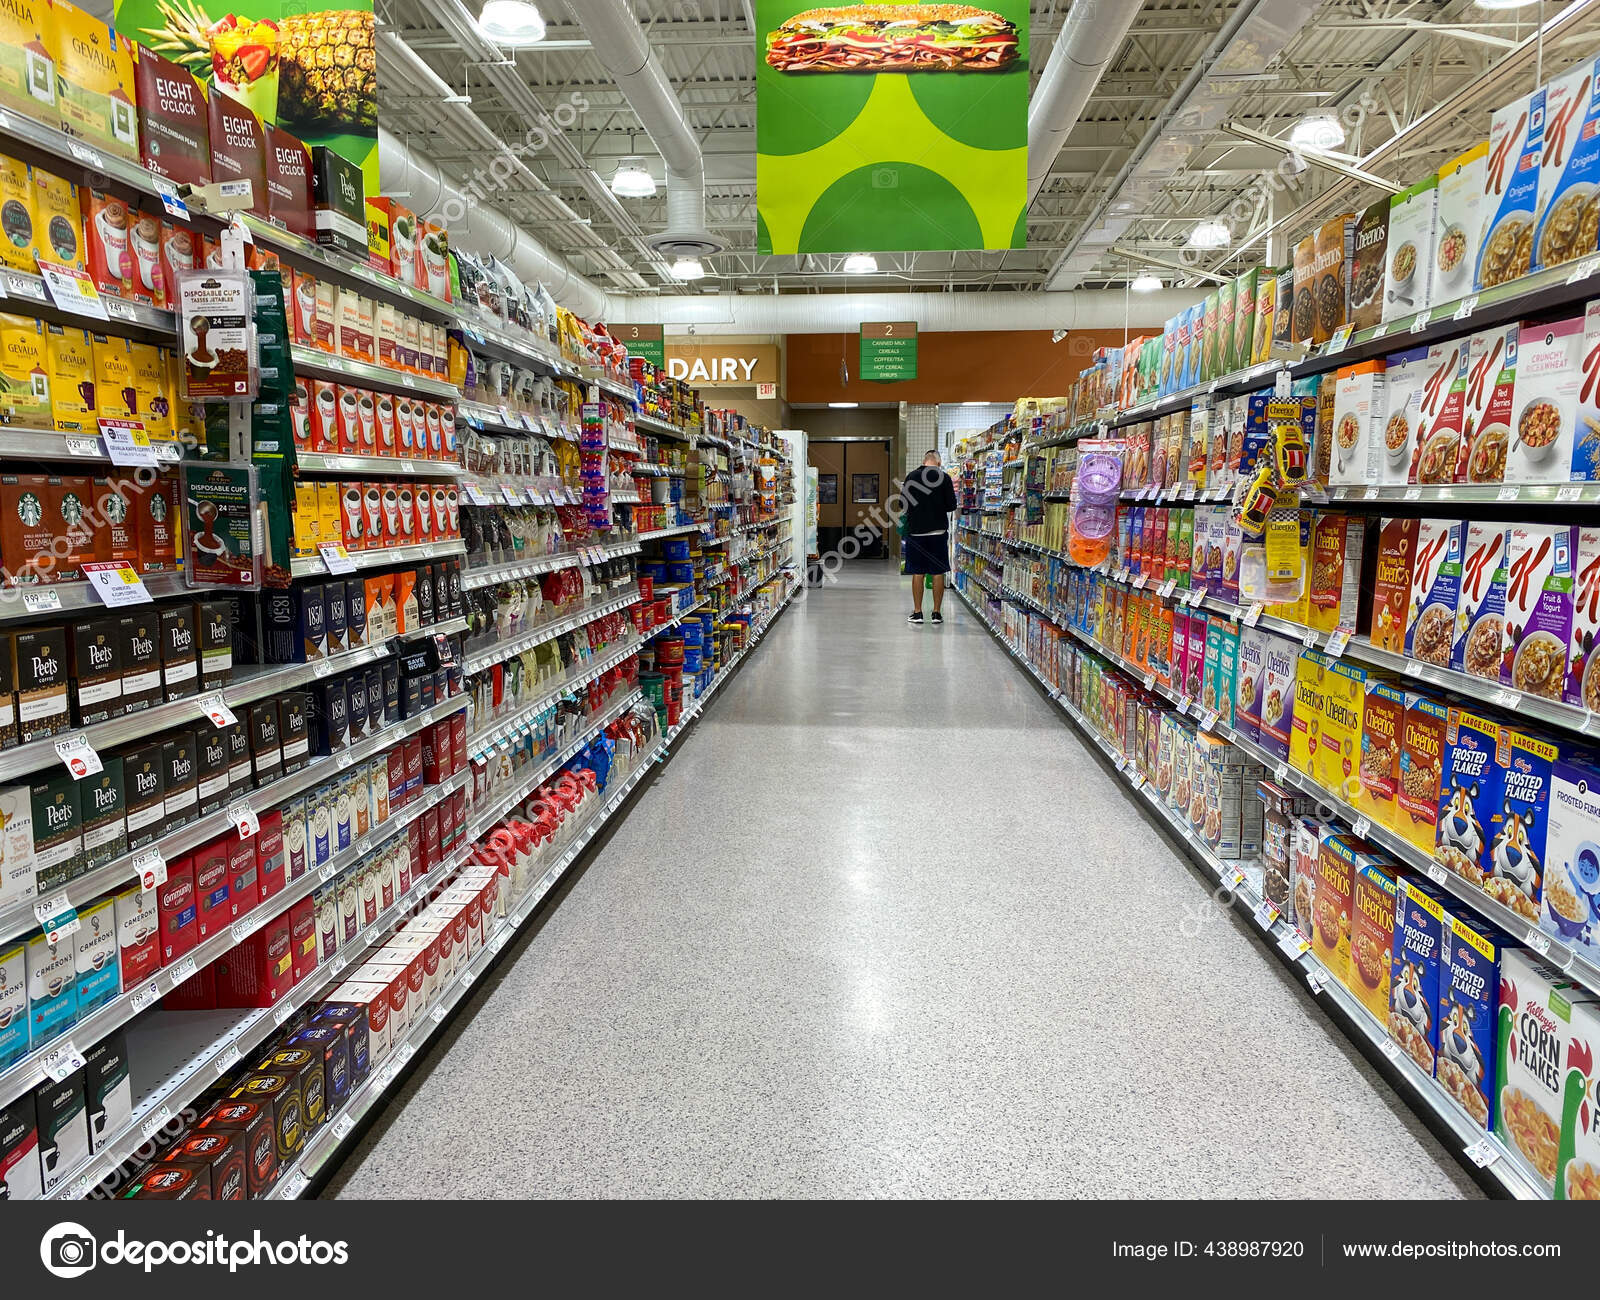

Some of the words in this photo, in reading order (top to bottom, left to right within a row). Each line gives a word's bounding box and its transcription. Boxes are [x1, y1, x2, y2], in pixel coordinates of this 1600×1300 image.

[72, 38, 118, 74] GEVALIA
[156, 78, 192, 101] EIGHT
[161, 101, 196, 116] O'CLOCK
[222, 115, 253, 136] EIGHT
[227, 135, 256, 149] O'CLOCK
[223, 156, 242, 170] ORIGINAL
[276, 147, 303, 165] EIGHT
[1571, 150, 1599, 169] Original
[279, 164, 305, 176] O'CLOCK
[1508, 181, 1536, 198] Original
[1356, 225, 1385, 251] Cheerios
[631, 327, 639, 338] 3
[885, 325, 893, 336] 2
[8, 343, 38, 356] GEVALIA
[1531, 351, 1563, 363] CRUNCHY
[59, 353, 86, 367] GEVALIA
[104, 361, 129, 373] GEVALIA
[668, 357, 759, 381] DAIRY
[138, 367, 161, 379] GEVALIA
[1466, 336, 1504, 411] K
[760, 384, 773, 394] EXIT
[1421, 349, 1459, 417] K
[1449, 397, 1457, 405] Red
[1497, 388, 1507, 398] Red
[1444, 405, 1460, 414] Berries
[1492, 398, 1511, 408] Berries
[191, 484, 229, 492] DISPOSABLE
[1414, 530, 1447, 593] K
[1463, 533, 1503, 602] K
[1508, 536, 1552, 612] K
[1543, 593, 1555, 603] Fruit
[1556, 595, 1562, 603] &
[1543, 602, 1561, 612] Yogurt
[308, 605, 323, 626] 1850
[331, 600, 344, 620] 1850
[171, 627, 191, 647] Peet's
[210, 621, 227, 639] Peet's
[88, 644, 113, 665] Peet's
[131, 636, 153, 657] Peet's
[1241, 643, 1261, 665] Cheerios
[32, 656, 58, 678] Peet's
[407, 656, 424, 666] SAVE
[1267, 651, 1290, 677] Cheerios
[1335, 662, 1350, 675] FAMILY
[352, 691, 366, 711] 1850
[369, 683, 382, 702] 1850
[1377, 687, 1388, 697] LARGE
[1389, 691, 1401, 700] SIZE
[126, 703, 133, 712] 10
[331, 698, 346, 720] 1850
[1419, 701, 1433, 711] LARGE
[1433, 705, 1446, 717] SIZE
[83, 715, 91, 725] 10
[289, 713, 302, 729] Peet's
[1366, 708, 1395, 737] Cheerios
[1462, 717, 1482, 729] LARGE
[1483, 722, 1496, 735] SIZE
[23, 733, 32, 742] 10
[261, 723, 275, 739] Peet's
[1406, 725, 1439, 756] Cheerios
[206, 747, 224, 764] Peet's
[1451, 747, 1487, 764] FROSTED
[1514, 736, 1535, 750] LARGE
[1536, 743, 1554, 758] SIZE
[172, 760, 191, 779] Peet's
[1452, 760, 1482, 776] FLAKES
[136, 772, 157, 793] Peet's
[1504, 770, 1543, 790] FROSTED
[94, 787, 117, 810] Peet's
[1505, 785, 1538, 804] FLAKES
[1557, 791, 1583, 810] FROSTED
[47, 804, 73, 828] Peet's
[53, 821, 69, 831] COFFEE
[260, 831, 282, 851] Community
[1328, 838, 1342, 853] FAMILY
[87, 860, 95, 869] 10
[230, 847, 254, 869] Community
[199, 862, 226, 886] Community
[1318, 852, 1350, 898] Cheerios
[1367, 868, 1383, 885] FAMILY
[1384, 880, 1396, 896] SIZE
[39, 880, 47, 890] 10
[1367, 883, 1382, 900] Honey
[163, 883, 192, 907] Community
[1409, 887, 1427, 905] FAMILY
[1427, 900, 1440, 914] SIZE
[124, 907, 156, 928] CAMERONS
[1356, 883, 1394, 935] Cheerios
[293, 917, 314, 937] Community
[1372, 929, 1384, 941] OATS
[1403, 925, 1434, 948] FROSTED
[80, 929, 114, 953] CAMERONS
[268, 934, 289, 953] Community
[1454, 922, 1474, 941] FAMILY
[1475, 937, 1489, 953] SIZE
[1404, 939, 1430, 959] FLAKES
[35, 954, 73, 978] CAMERONS
[1450, 962, 1485, 988] FROSTED
[1452, 976, 1481, 1001] FLAKES
[1526, 1001, 1557, 1033] Kellogg's
[1521, 1012, 1560, 1070] CORN
[1519, 1040, 1560, 1094] FLAKES
